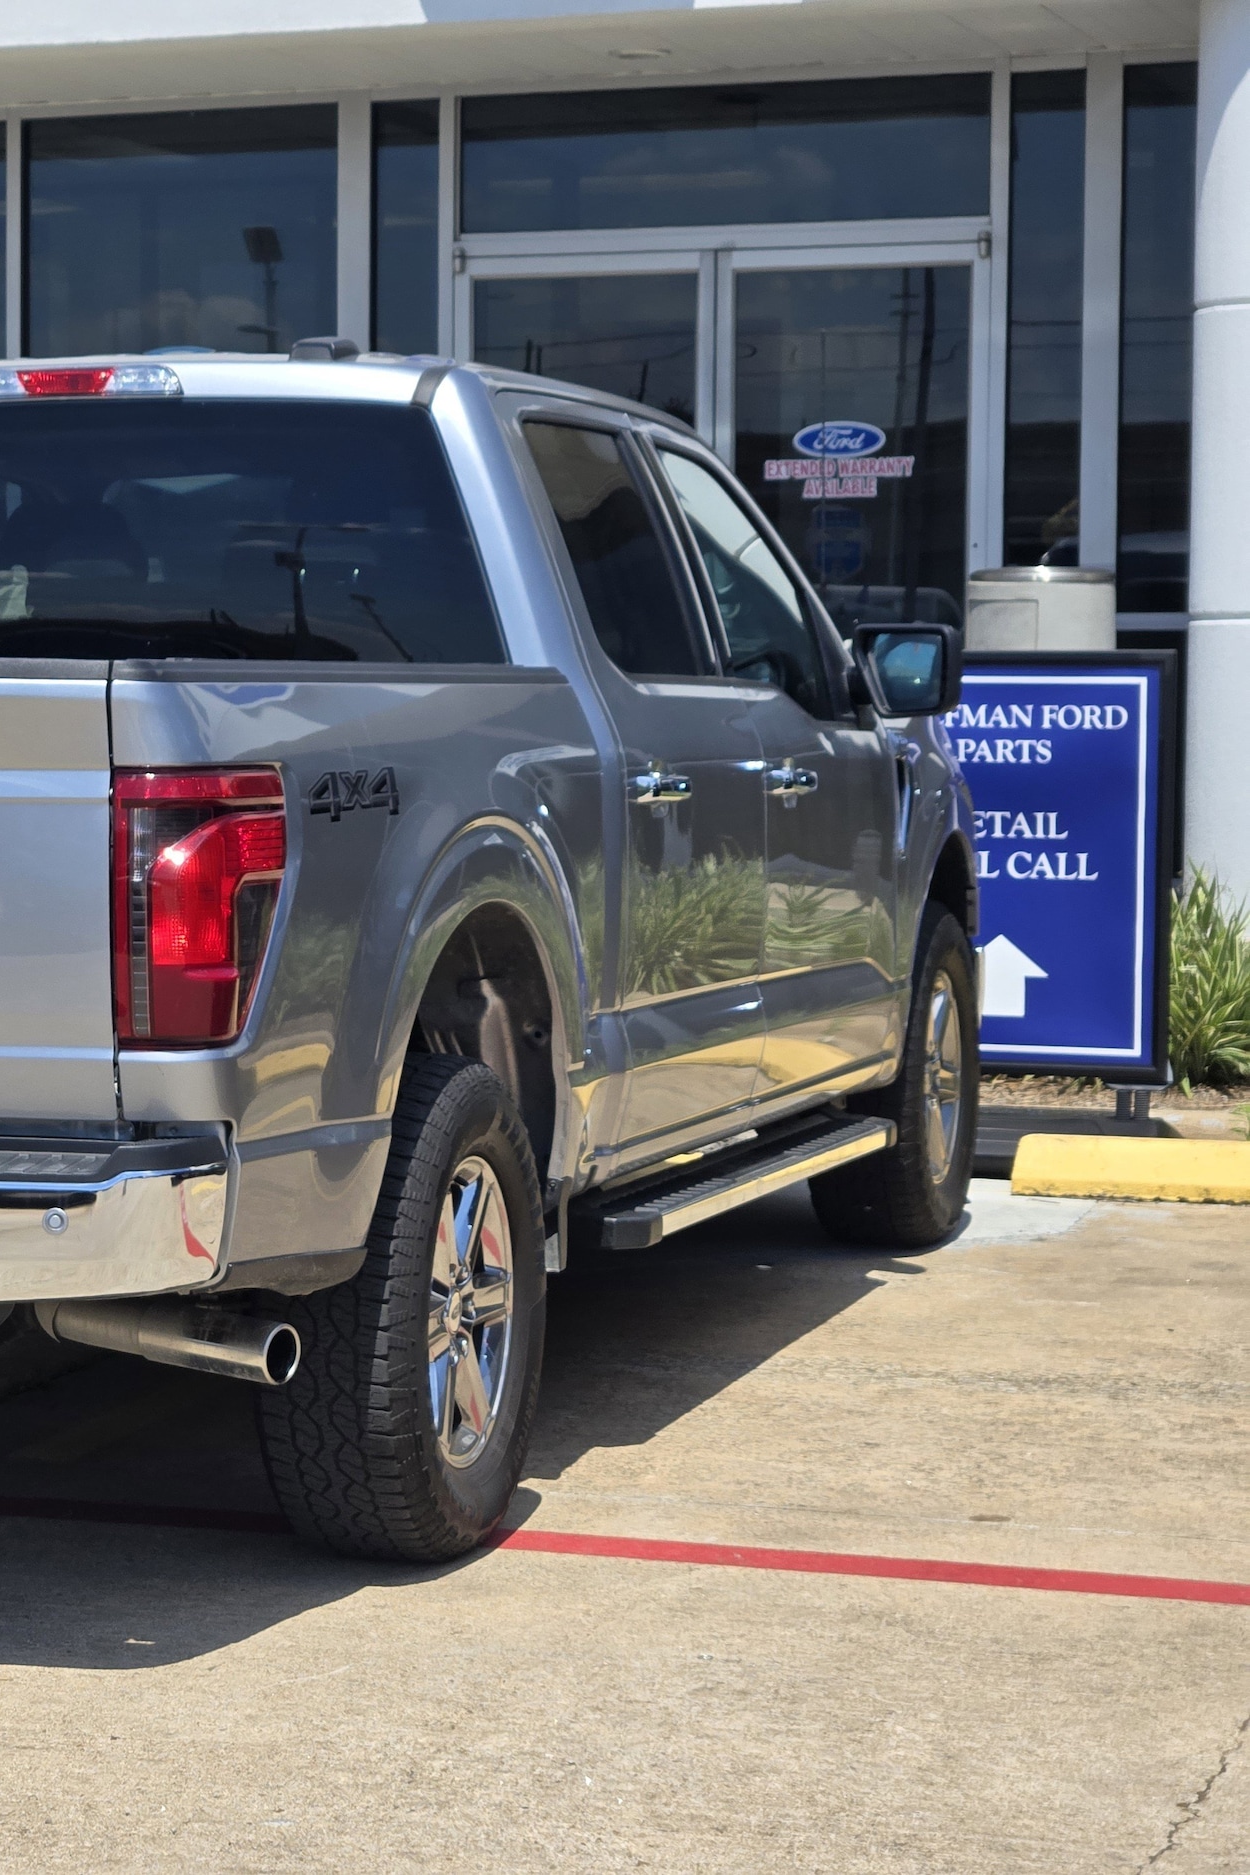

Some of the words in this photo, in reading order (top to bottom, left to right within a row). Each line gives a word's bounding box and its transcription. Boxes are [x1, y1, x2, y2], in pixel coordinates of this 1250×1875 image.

[812, 427, 866, 449] Ford
[838, 456, 915, 477] WARRANTY
[803, 477, 878, 498] AVAILABLE
[944, 703, 1034, 729] FMAN
[1040, 704, 1129, 730] FORD
[956, 738, 1053, 764] PARTS
[972, 810, 1069, 839] ETAIL
[1006, 850, 1099, 881] CALL
